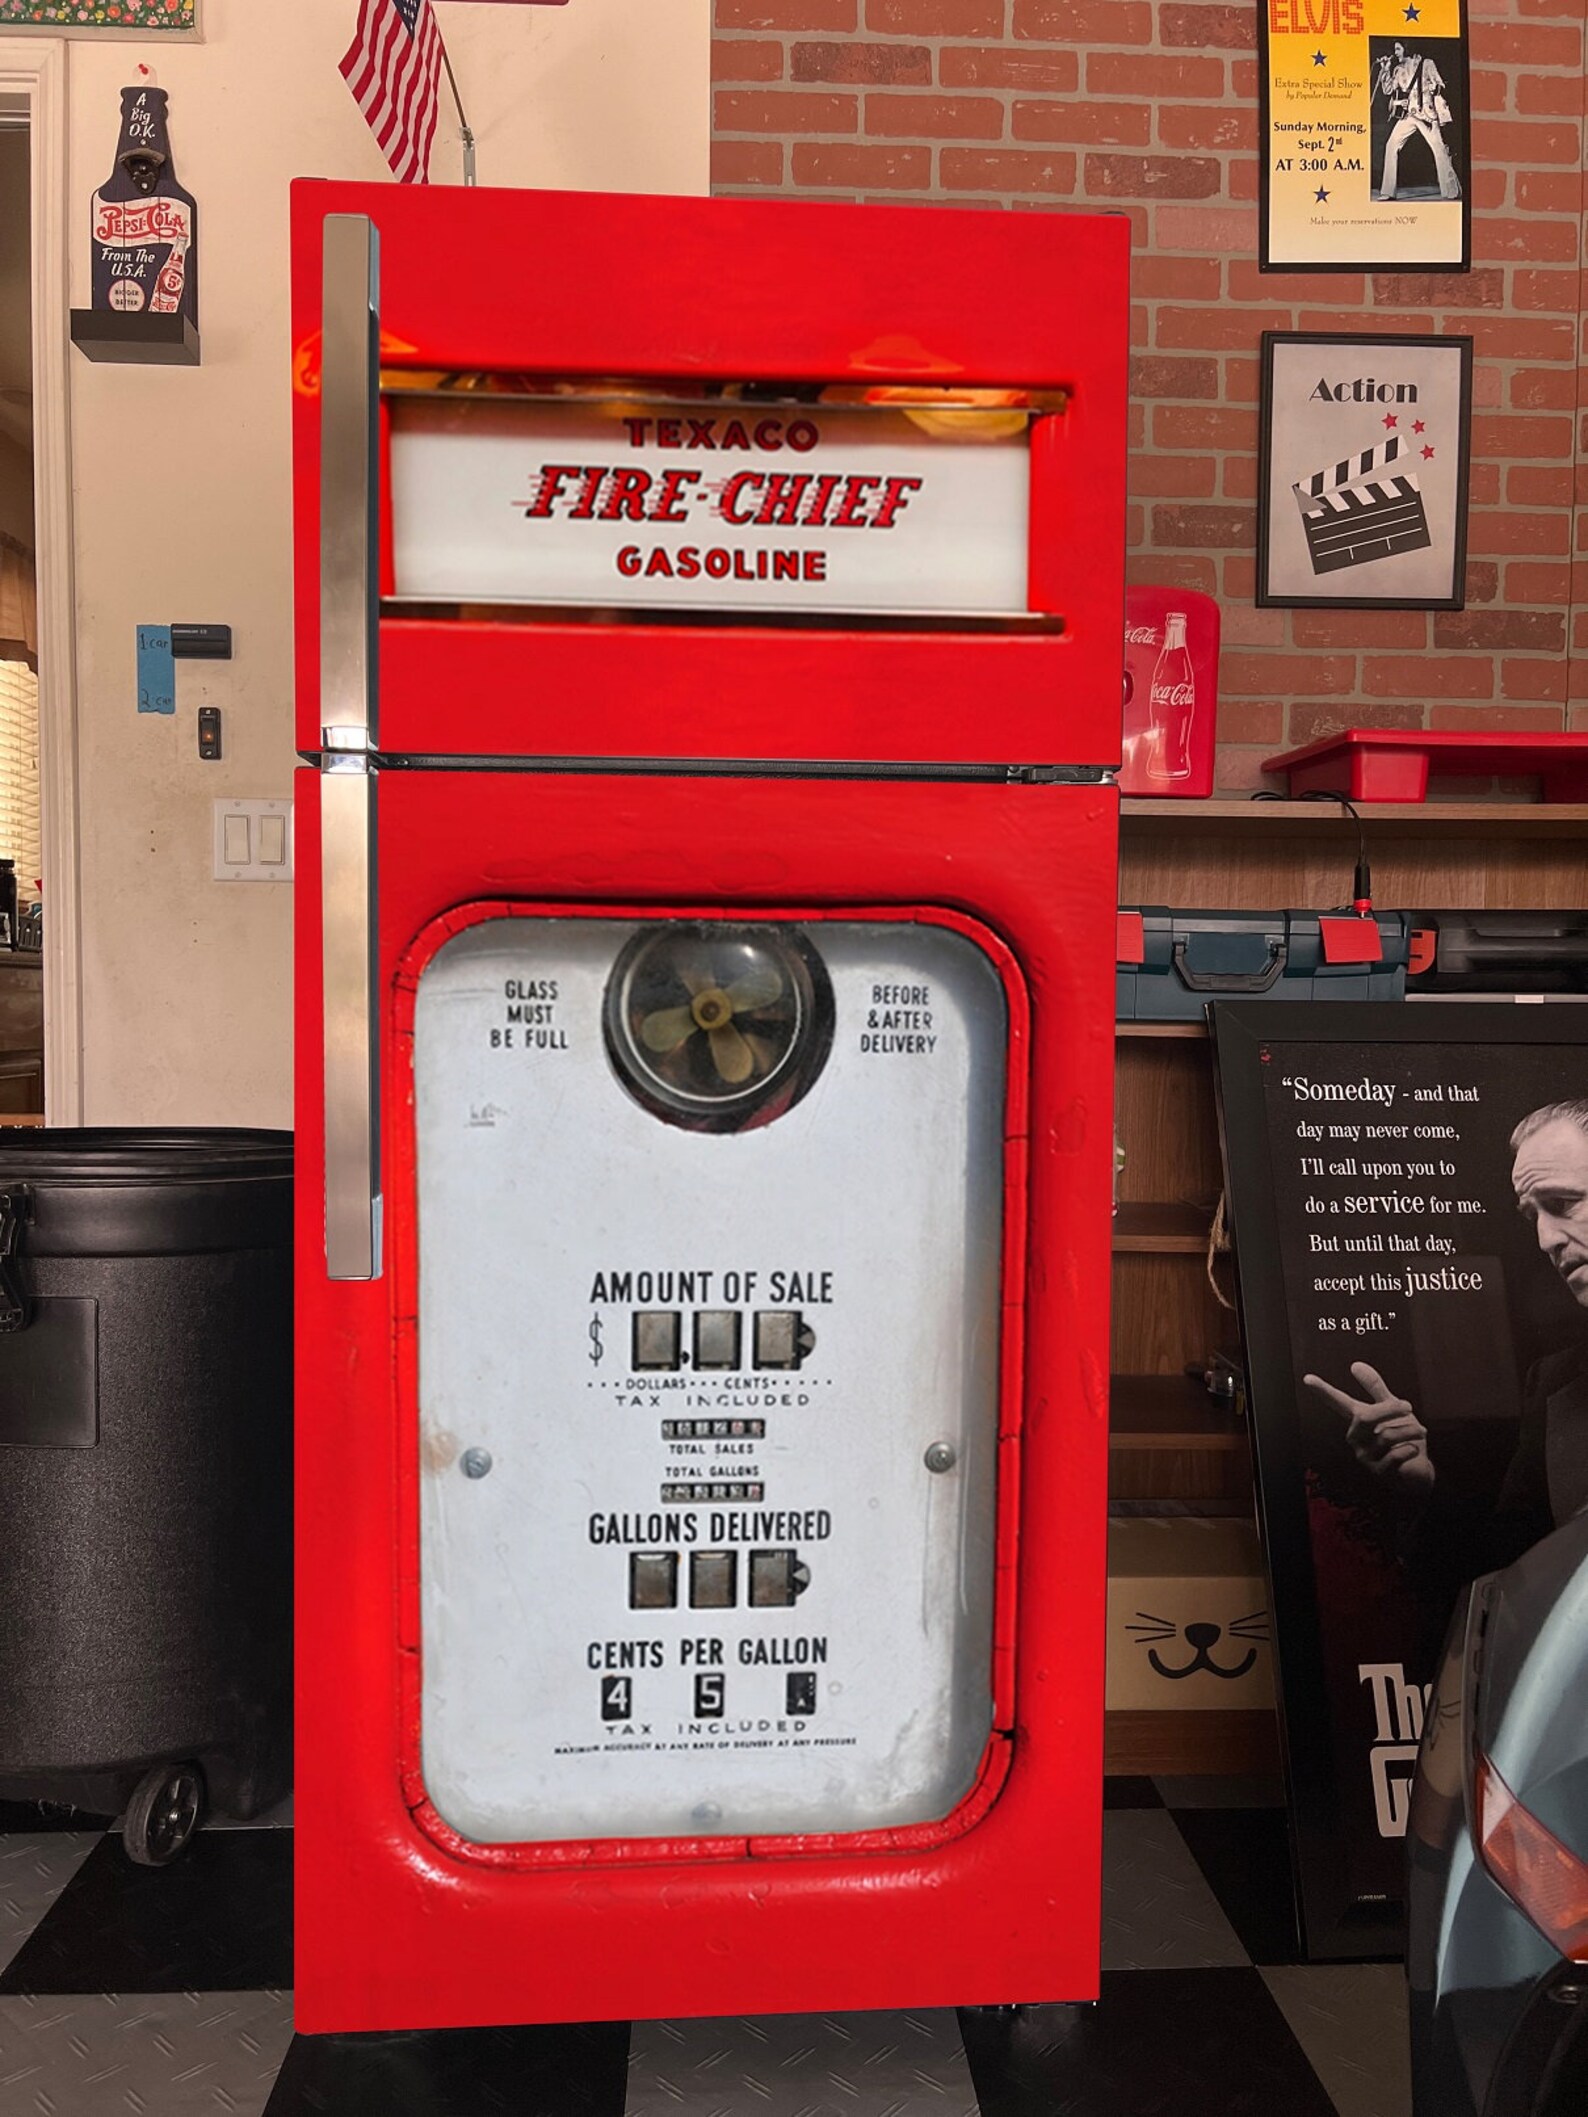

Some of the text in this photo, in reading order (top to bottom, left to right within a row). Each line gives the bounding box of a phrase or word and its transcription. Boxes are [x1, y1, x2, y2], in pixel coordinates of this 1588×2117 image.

[1270, 0, 1364, 34] ELVIS
[1275, 77, 1363, 90] Extra Special Show
[136, 92, 147, 106] A
[1286, 90, 1294, 100] by
[1324, 90, 1352, 99] Demand
[131, 107, 151, 125] Big
[129, 123, 155, 138] O.K.
[1274, 121, 1367, 134] Sunday Morning,
[1298, 139, 1325, 152] Sept.
[1275, 158, 1365, 171] AT 3:00 A.M.
[1310, 216, 1418, 227] Make your reservations NOW
[101, 247, 156, 263] From The
[111, 262, 147, 278] U.S.A.
[1309, 377, 1418, 403] Action
[623, 417, 819, 452] TEXACO
[522, 465, 922, 528] FIRE-CHIEF
[617, 545, 826, 581] GASOLINE
[505, 979, 558, 1000] GLASS
[873, 984, 929, 1005] BEFORE
[507, 1005, 553, 1024] MUST
[490, 1029, 568, 1049] BE FULL
[861, 1034, 937, 1054] DELIVERY
[1282, 1077, 1396, 1107] "Someday
[1414, 1085, 1444, 1102] and
[1448, 1085, 1480, 1102] that
[1296, 1121, 1461, 1142] day may never come,
[1300, 1158, 1456, 1180] I'll call upon you to
[1305, 1190, 1487, 1214] do a service for me.
[1309, 1234, 1457, 1256] But until that day,
[590, 1271, 833, 1303] AMOUNT OF SALE
[1314, 1266, 1483, 1298] accept this justice
[1318, 1312, 1396, 1335] as a gift."
[588, 1312, 604, 1368] $
[626, 1377, 769, 1390] DOLLARS CENTS
[615, 1394, 810, 1407] TAX INCLUDED
[669, 1443, 754, 1455] TOTAL SALES
[666, 1465, 760, 1478] TOTAL GALLONS
[589, 1510, 832, 1545] GALLONS DELIVERED
[587, 1637, 828, 1669] CENTS PER GALLON
[606, 1676, 721, 1712] 4 5
[606, 1719, 806, 1735] TAX INCLUDED
[718, 1741, 730, 1750] OF
[734, 1740, 773, 1749] DELIVERY
[778, 1739, 790, 1748] AT
[793, 1739, 811, 1748] ANY
[814, 1737, 857, 1747] PRESSURE
